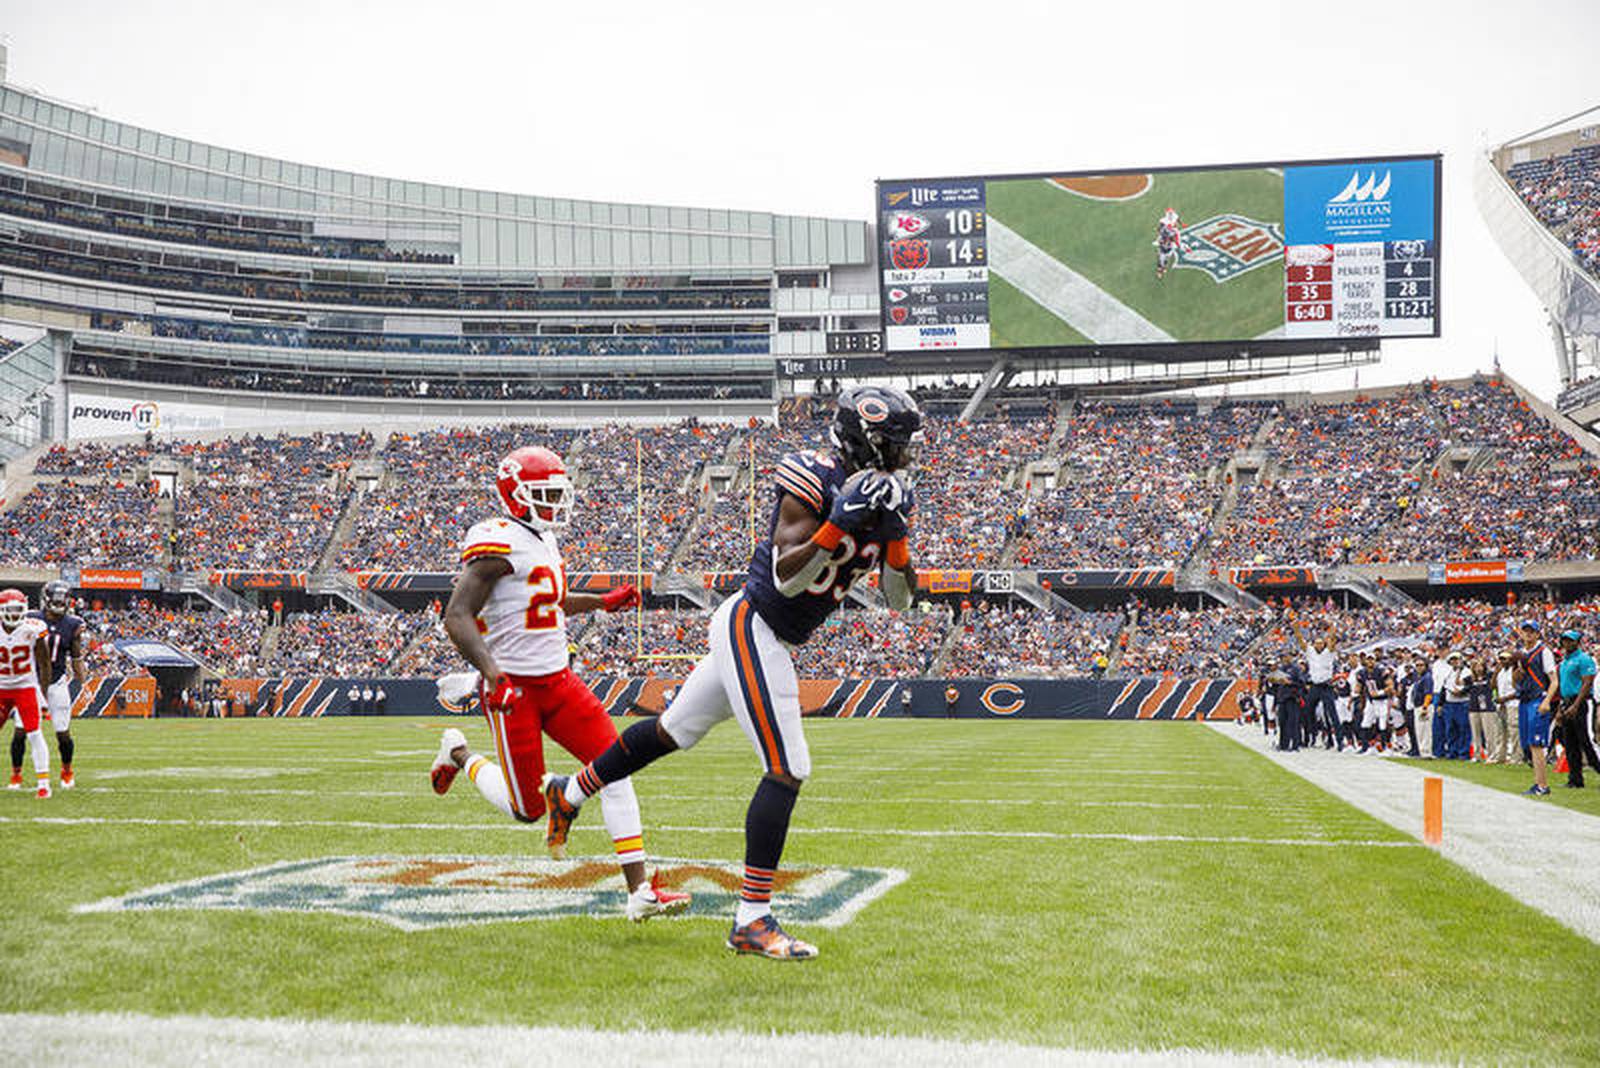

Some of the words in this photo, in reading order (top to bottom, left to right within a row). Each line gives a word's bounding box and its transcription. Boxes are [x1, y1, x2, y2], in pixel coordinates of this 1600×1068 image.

[1326, 205, 1391, 217] MAGELLAN
[945, 209, 972, 234] 10
[946, 239, 973, 265] 14
[1305, 267, 1314, 280] 3
[1403, 263, 1413, 276] 4
[1301, 286, 1319, 299] 35
[1400, 282, 1418, 296] 28
[1294, 306, 1325, 320] 6:40
[1390, 302, 1428, 316] 11:21
[72, 405, 132, 423] proven
[139, 409, 152, 423] IT
[525, 565, 566, 630] 2
